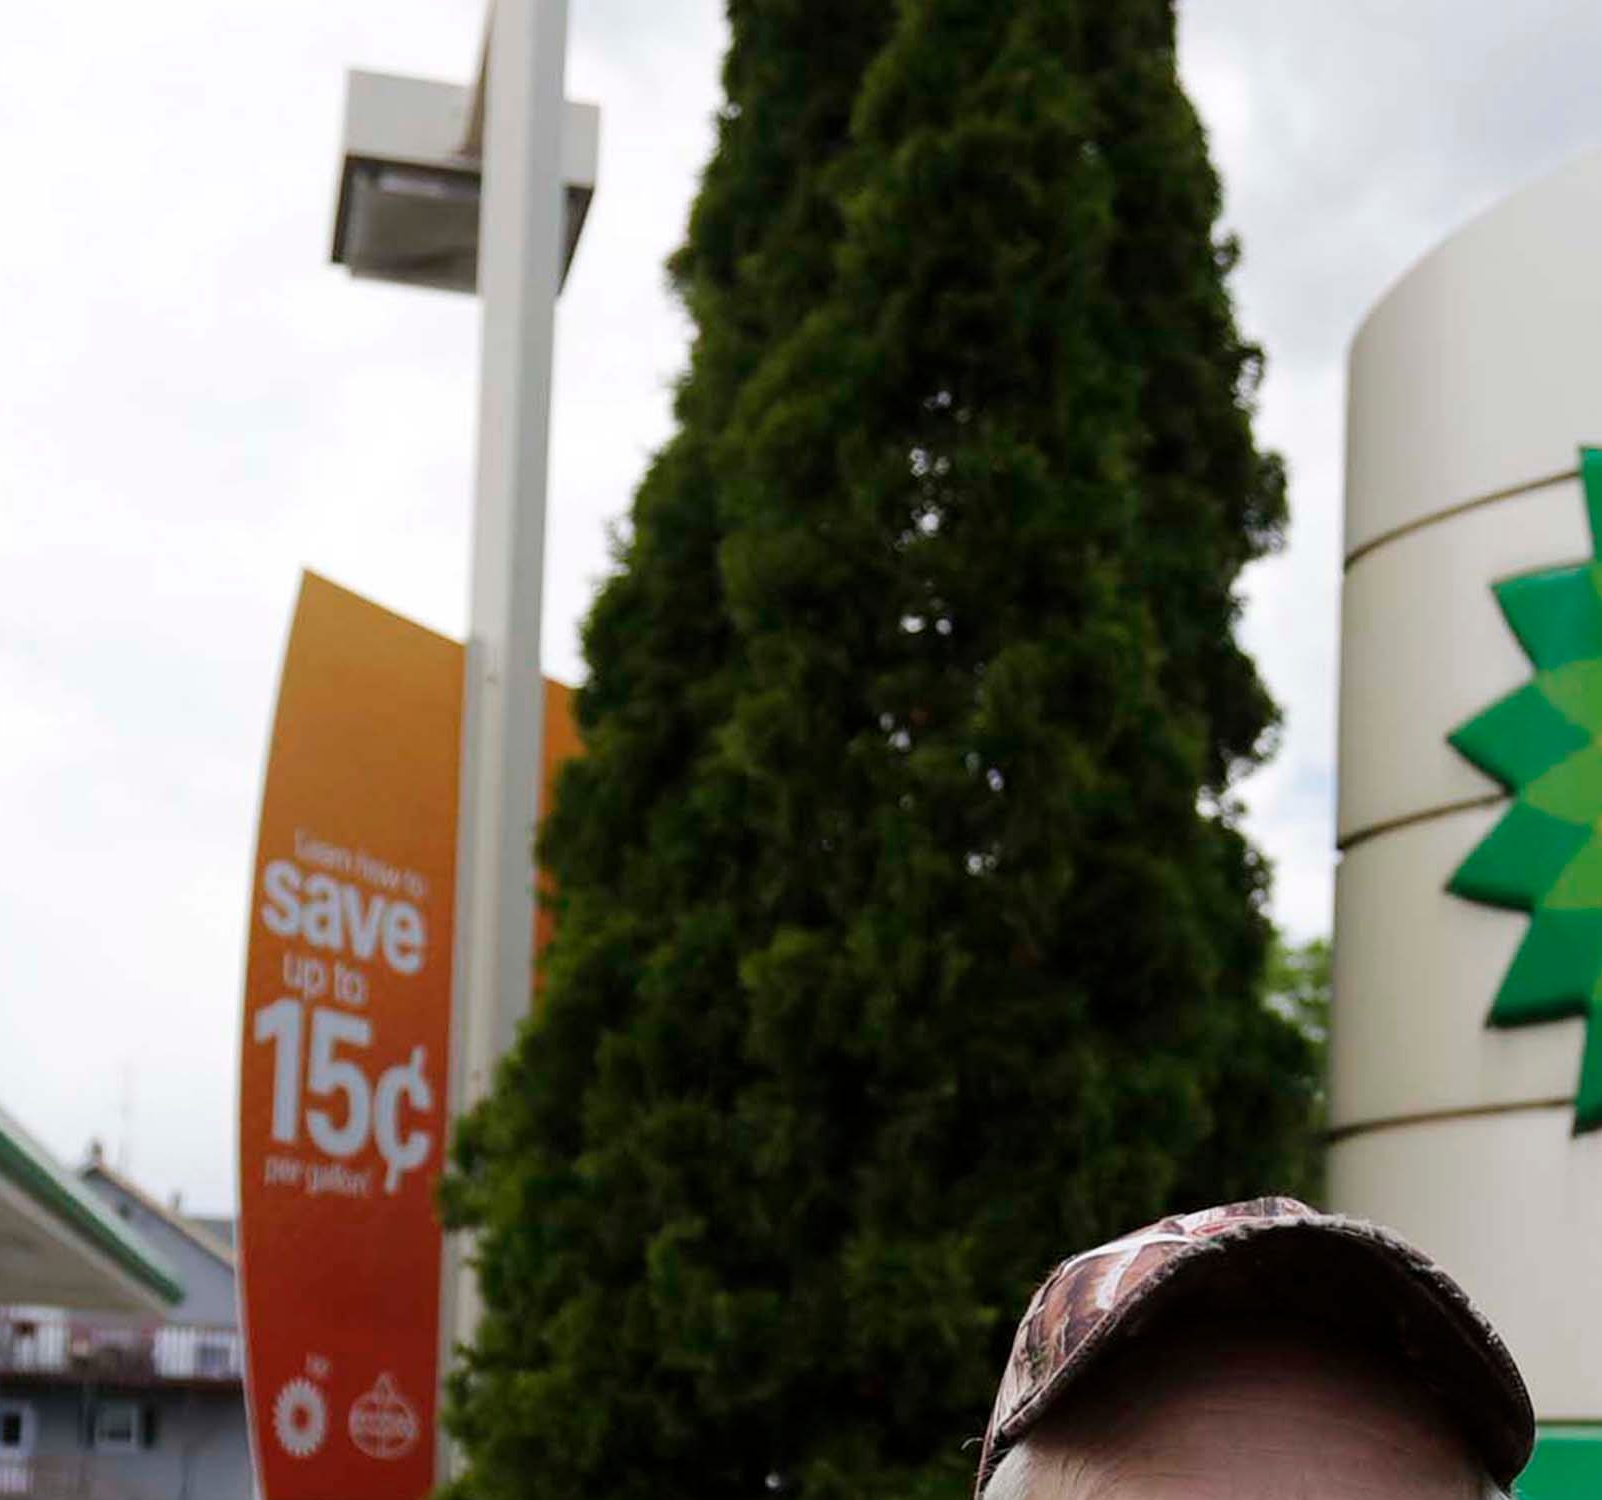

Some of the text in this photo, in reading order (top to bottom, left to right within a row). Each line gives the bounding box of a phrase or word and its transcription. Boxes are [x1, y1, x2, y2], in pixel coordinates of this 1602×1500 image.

[263, 859, 425, 975] save
[283, 951, 369, 1006] up to
[254, 997, 432, 1194] 15¢
